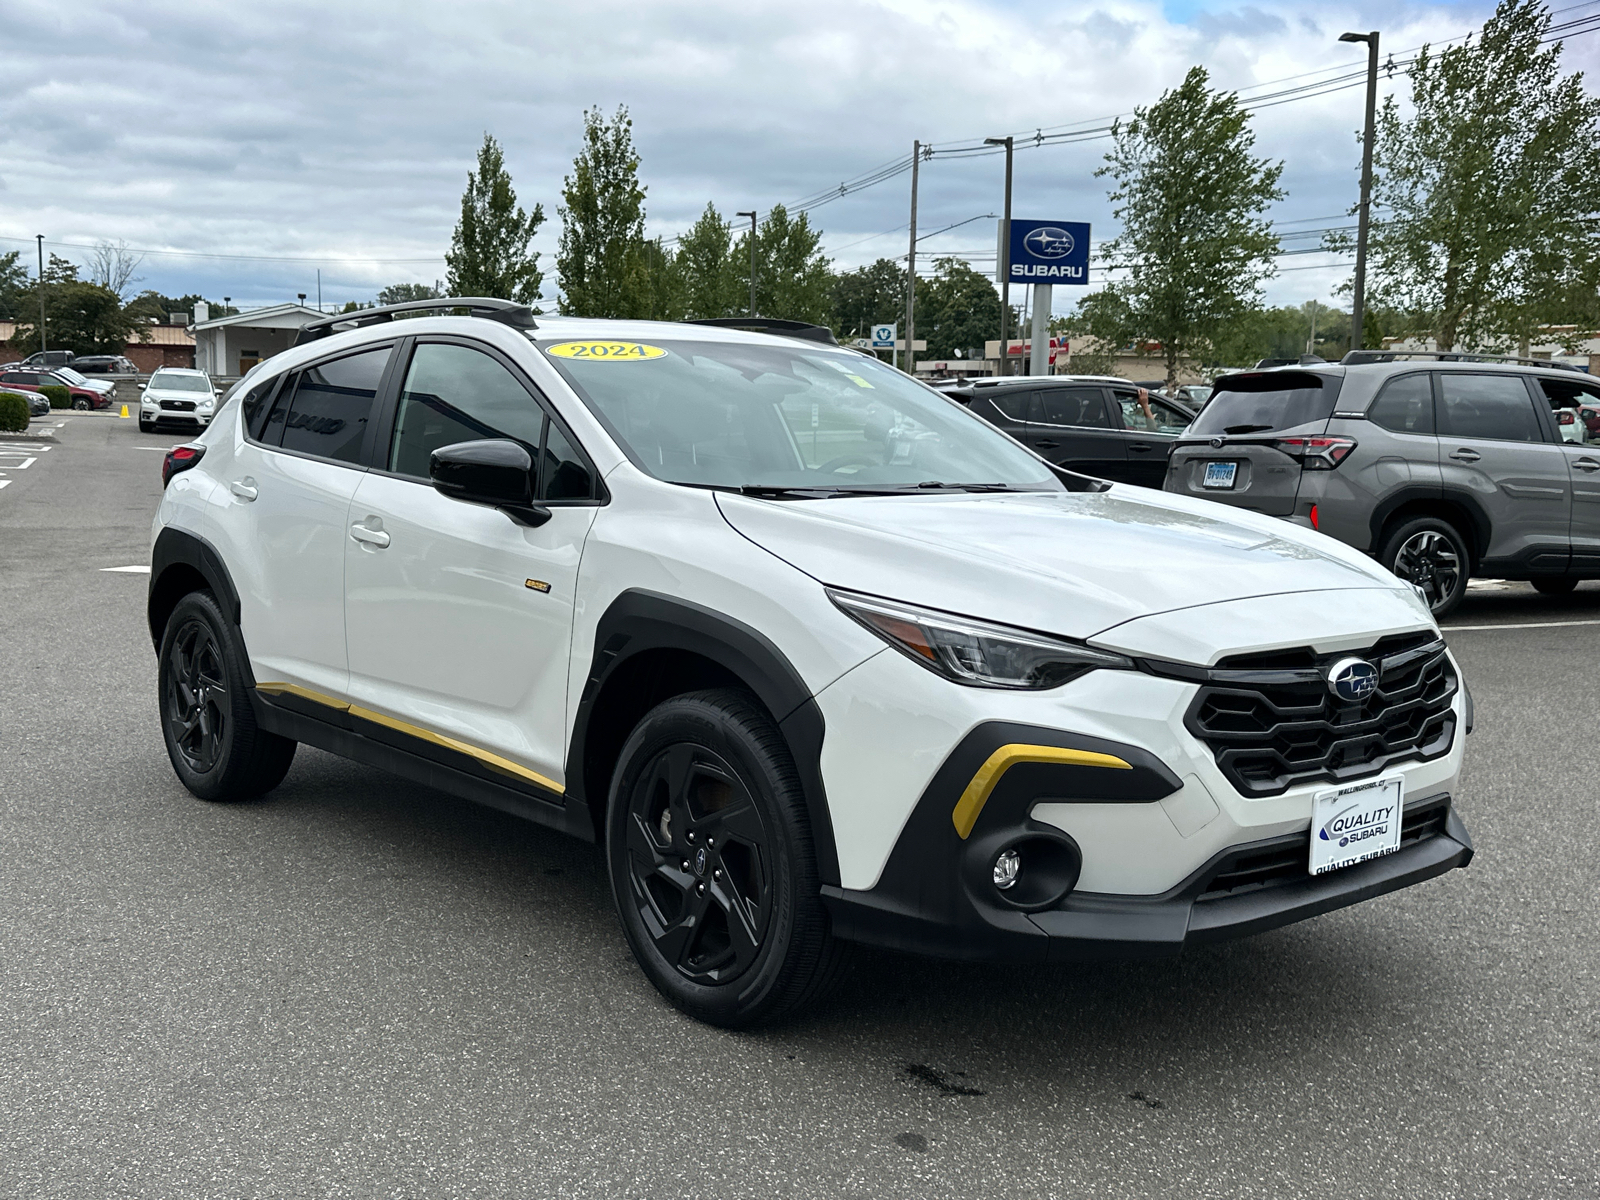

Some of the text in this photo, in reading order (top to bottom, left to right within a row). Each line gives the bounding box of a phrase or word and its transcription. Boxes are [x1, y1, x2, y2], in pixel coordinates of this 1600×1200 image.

[1011, 264, 1083, 278] SUBARU
[570, 345, 649, 357] 2024
[1333, 805, 1394, 833] QUALITY
[1349, 825, 1388, 843] SUBARU
[1316, 845, 1398, 875] QUALITY SUBARU
